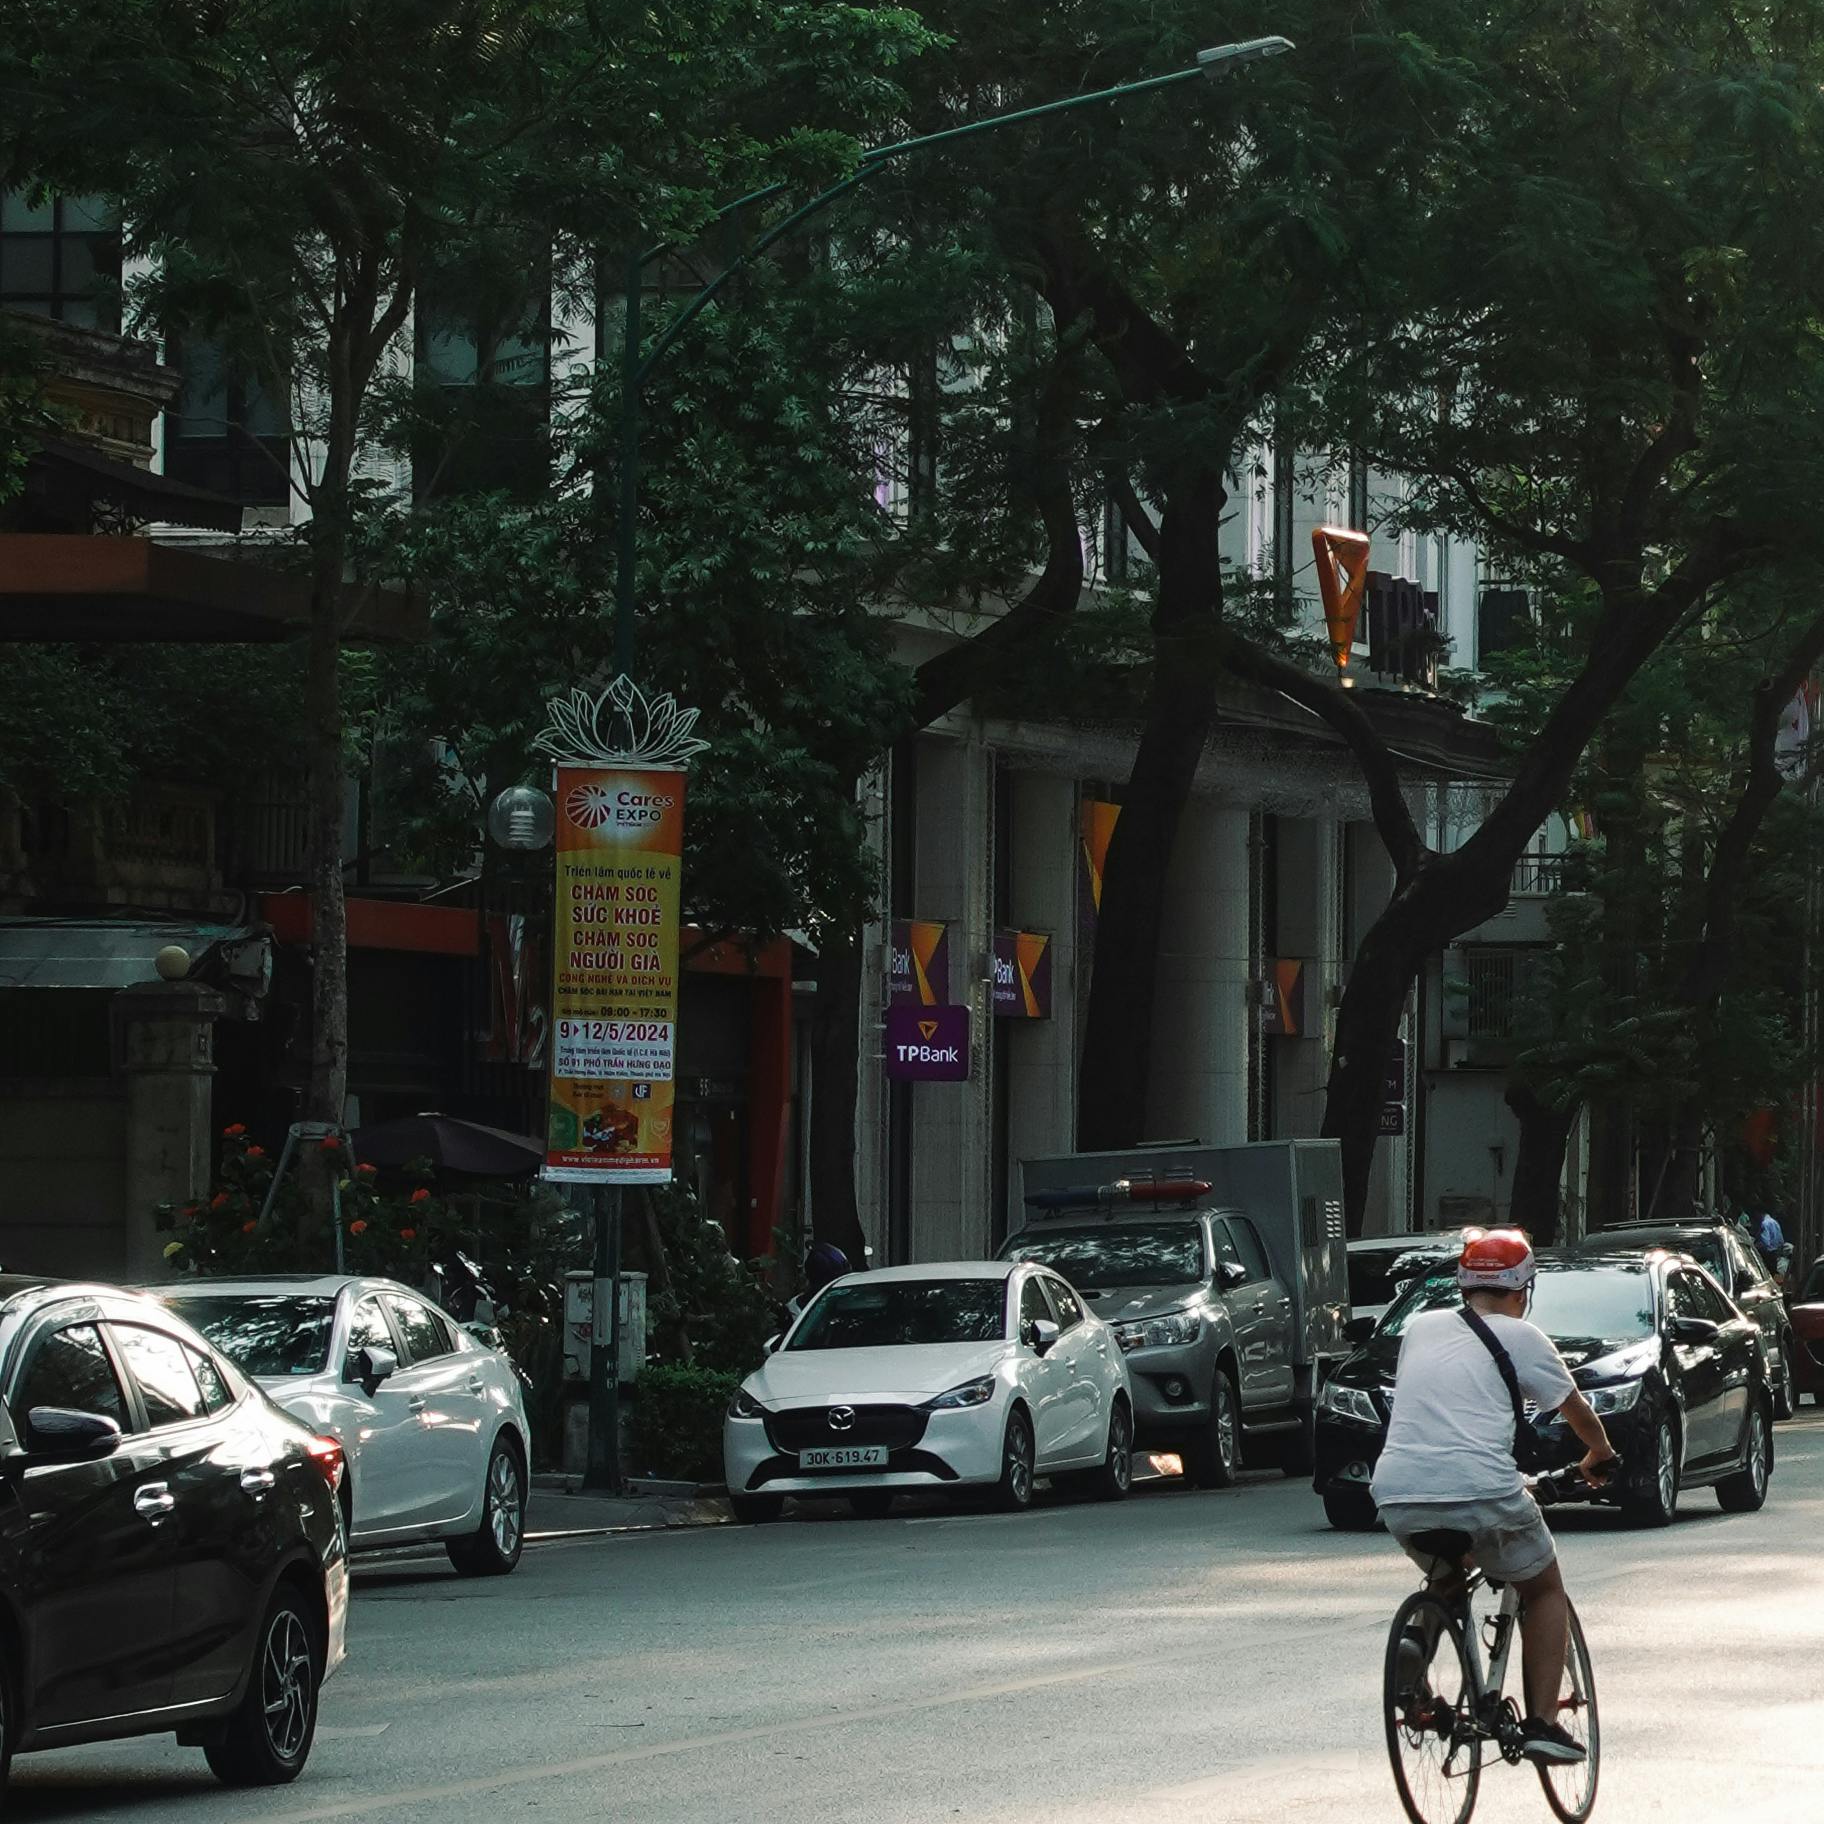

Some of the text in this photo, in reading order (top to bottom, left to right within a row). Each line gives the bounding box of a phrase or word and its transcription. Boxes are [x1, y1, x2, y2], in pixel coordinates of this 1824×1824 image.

[617, 791, 674, 807] Cares
[617, 809, 661, 822] EXPO
[561, 1022, 668, 1042] 9 12/5/2024
[897, 1045, 960, 1063] TPBank
[807, 1450, 880, 1465] 30K-619.47
